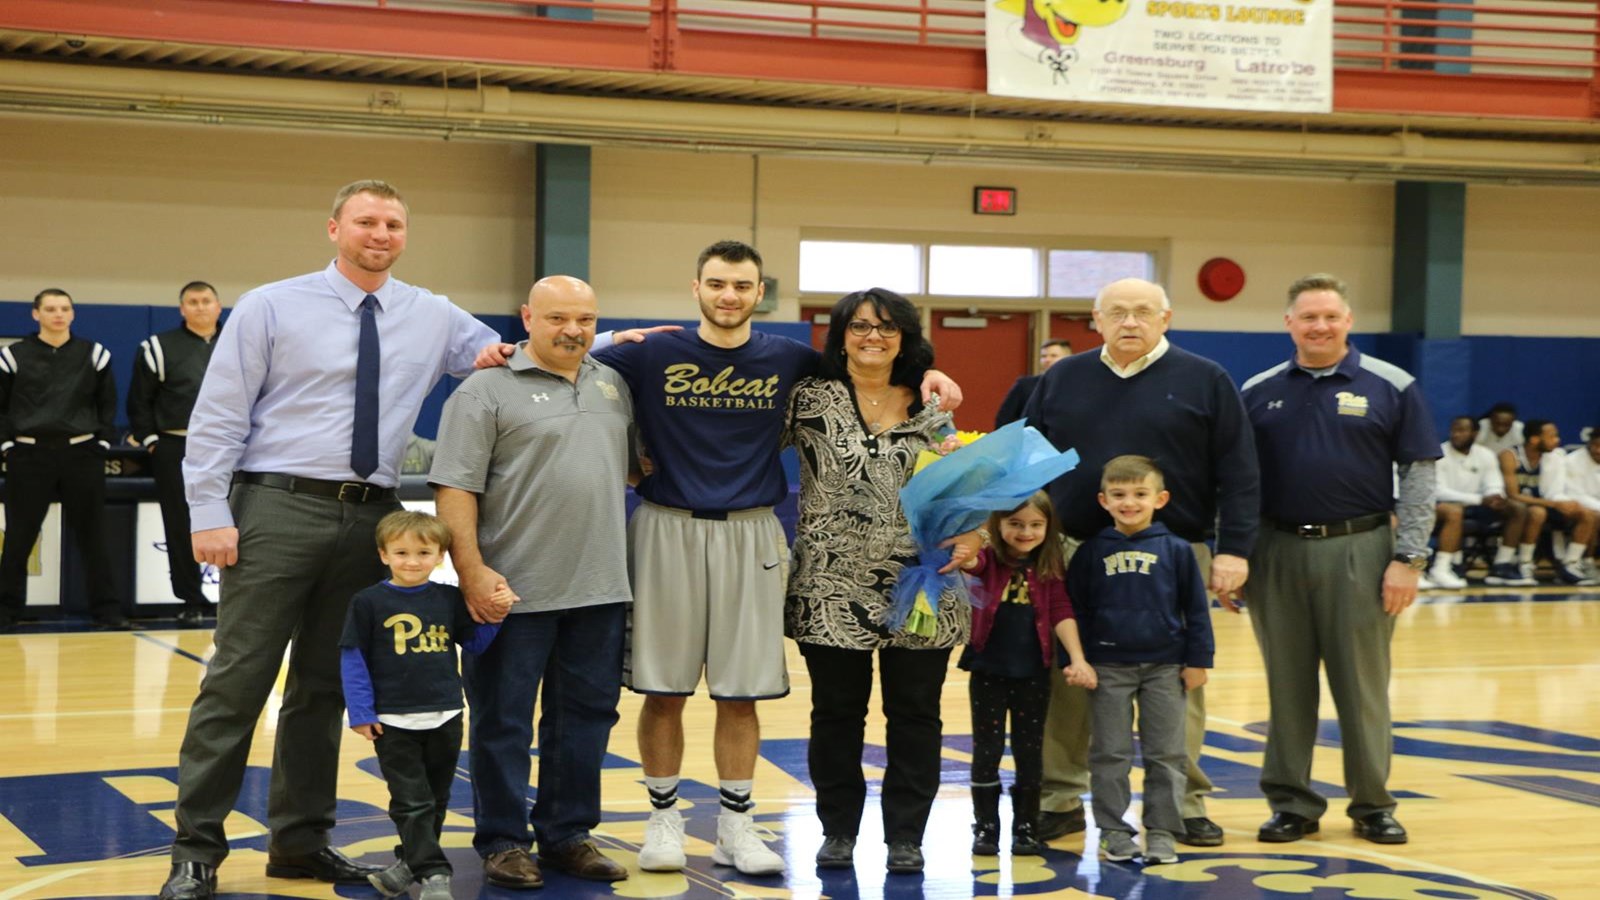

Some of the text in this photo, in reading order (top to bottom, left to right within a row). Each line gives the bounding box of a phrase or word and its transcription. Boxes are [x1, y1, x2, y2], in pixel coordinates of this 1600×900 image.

[1146, 1, 1305, 26] SPORTS LOUNGE
[1153, 41, 1195, 52] SERVE
[1154, 30, 1281, 46] TWO LOCATIONS TO
[1104, 51, 1206, 72] Greensburg
[1235, 58, 1316, 76] Latrobe
[664, 363, 779, 398] Bobcat
[665, 395, 776, 409] BASKETBALL
[1103, 550, 1158, 576] PITT
[383, 612, 450, 655] Pitt
